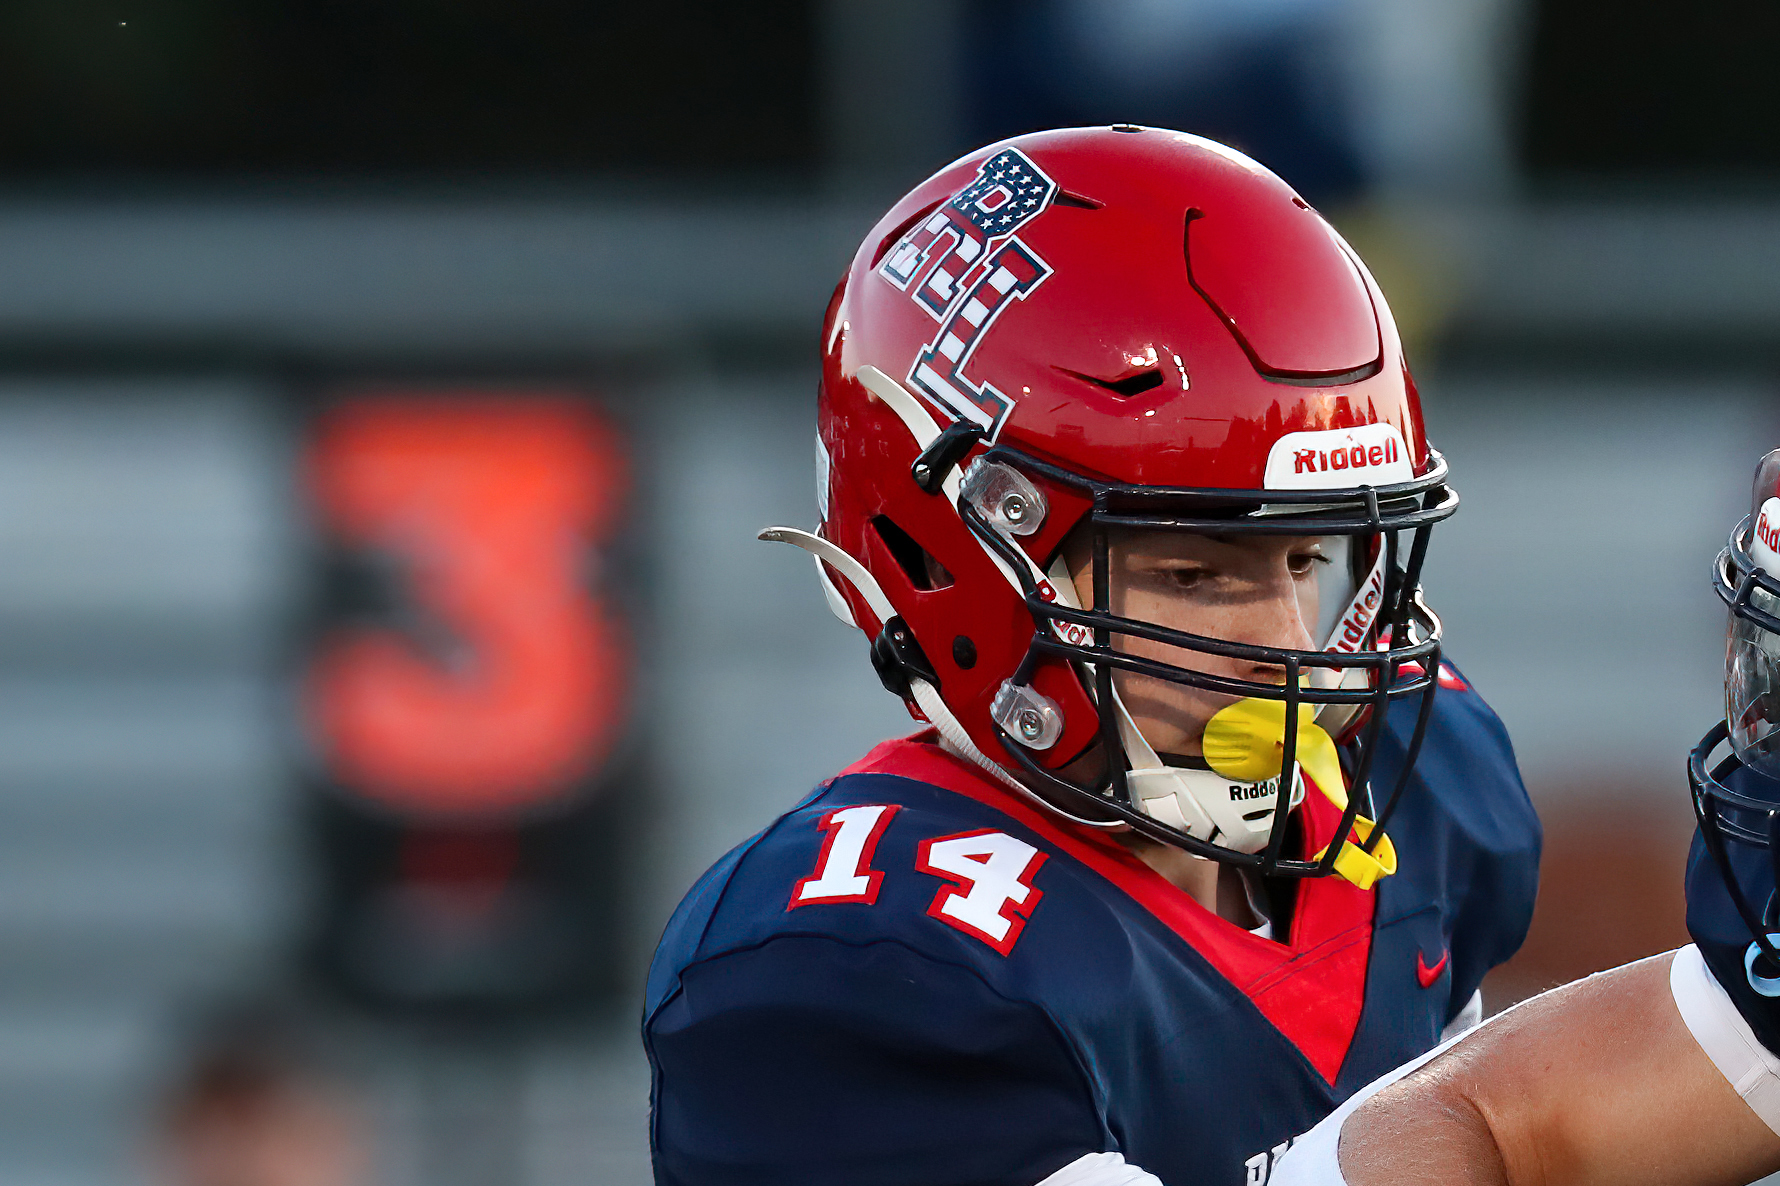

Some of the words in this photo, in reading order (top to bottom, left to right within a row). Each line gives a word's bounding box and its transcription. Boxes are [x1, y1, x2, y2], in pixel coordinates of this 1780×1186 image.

[1293, 436, 1399, 474] Riddell
[305, 390, 630, 808] 3
[1229, 776, 1281, 801] Ridde
[786, 804, 1049, 957] 14
